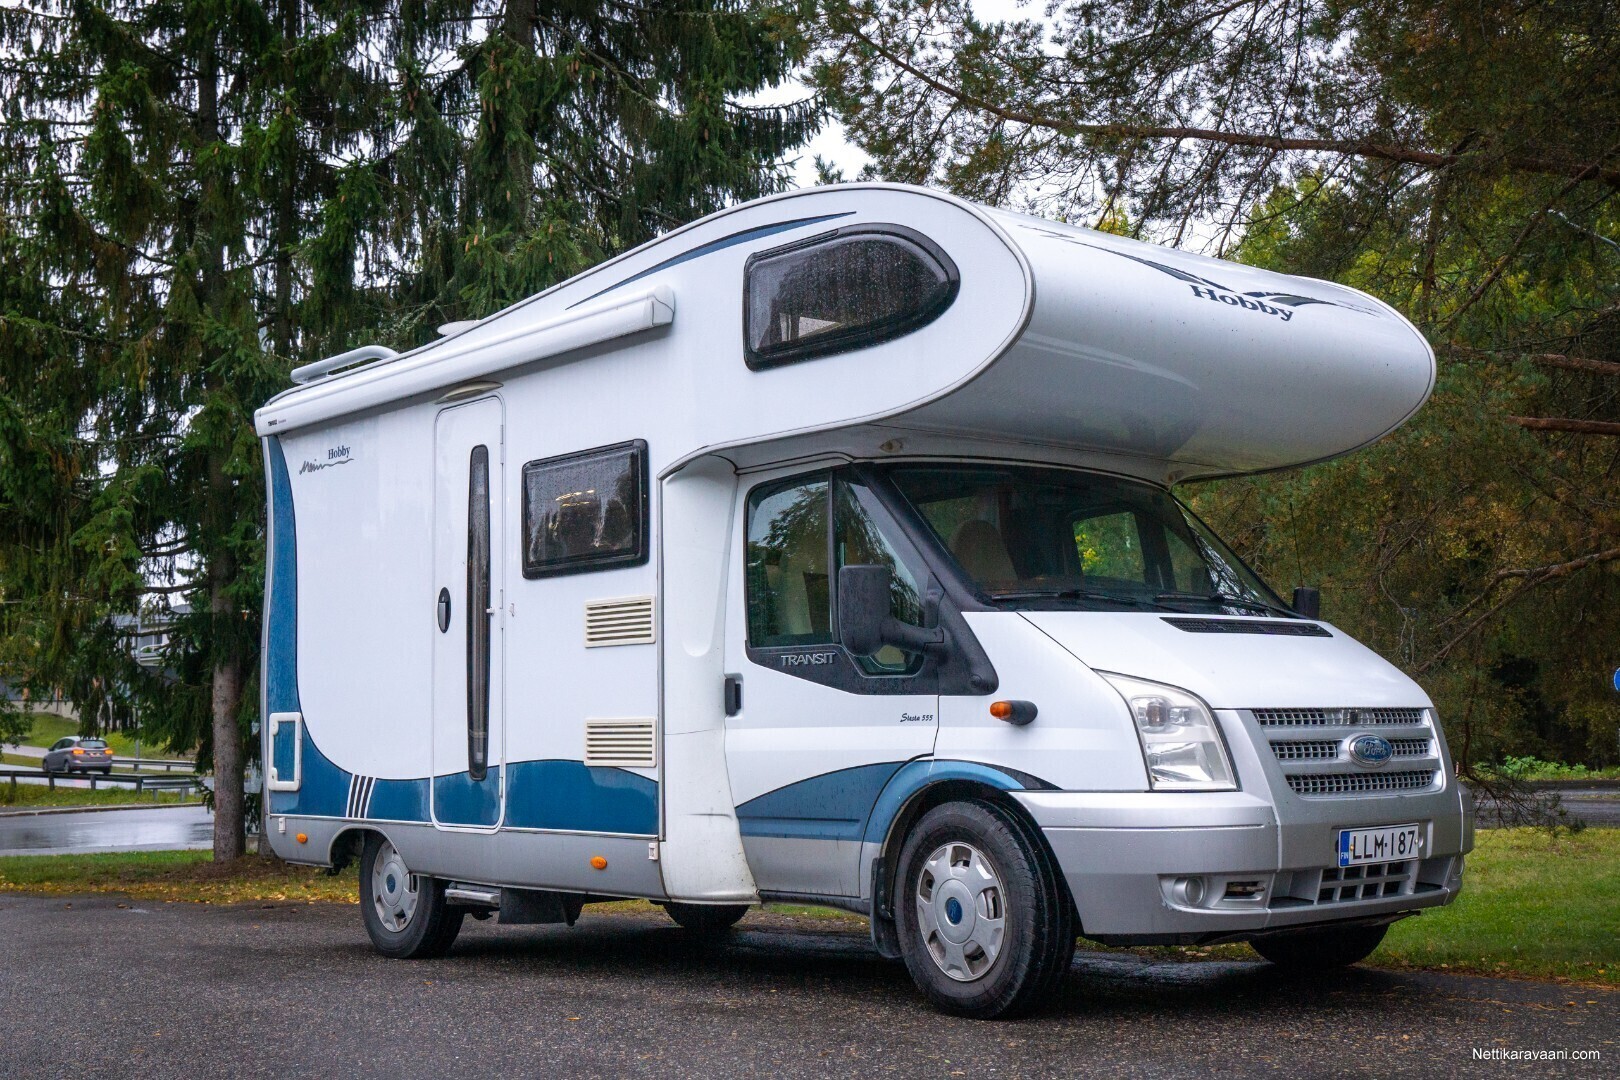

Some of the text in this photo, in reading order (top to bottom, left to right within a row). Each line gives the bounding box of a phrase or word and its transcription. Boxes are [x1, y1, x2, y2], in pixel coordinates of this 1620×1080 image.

[1189, 284, 1294, 322] Hobby
[328, 445, 351, 460] Hobby
[780, 652, 836, 667] TRANSIT
[921, 714, 934, 722] 555
[1363, 739, 1388, 757] Ford
[1340, 830, 1416, 860] FIN LLM-187
